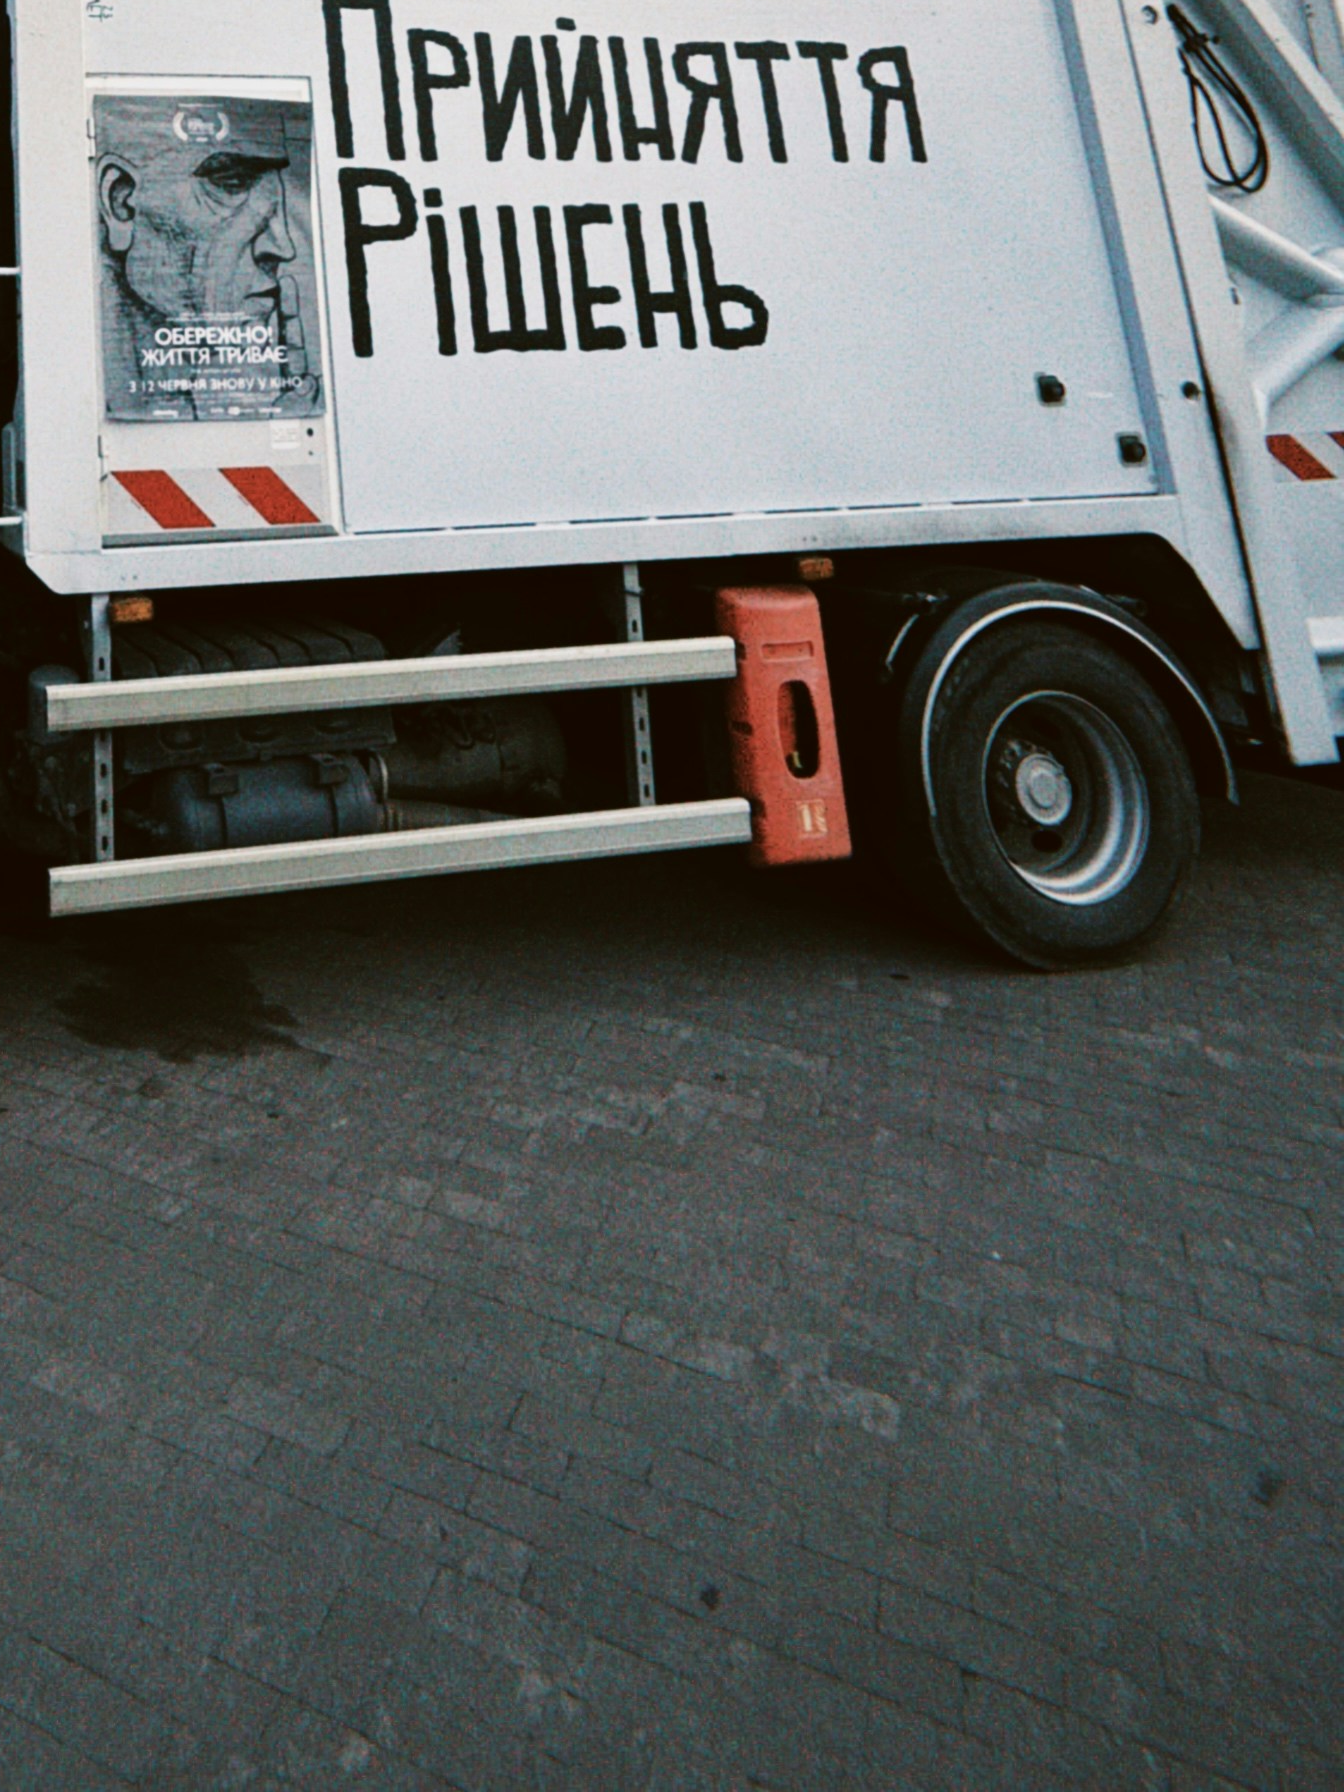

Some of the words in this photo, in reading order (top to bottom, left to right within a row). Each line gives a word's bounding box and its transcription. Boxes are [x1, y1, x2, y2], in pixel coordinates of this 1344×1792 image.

[154, 325, 274, 346] ОБЕРЕЖНО!
[141, 347, 210, 367] ЖИТТЯ
[214, 345, 288, 365] ТРИВАЄ
[141, 380, 155, 393] 12
[158, 378, 207, 392] ЧЕРВНЯ
[210, 377, 255, 392] ЗНОВУ
[258, 376, 267, 390] У
